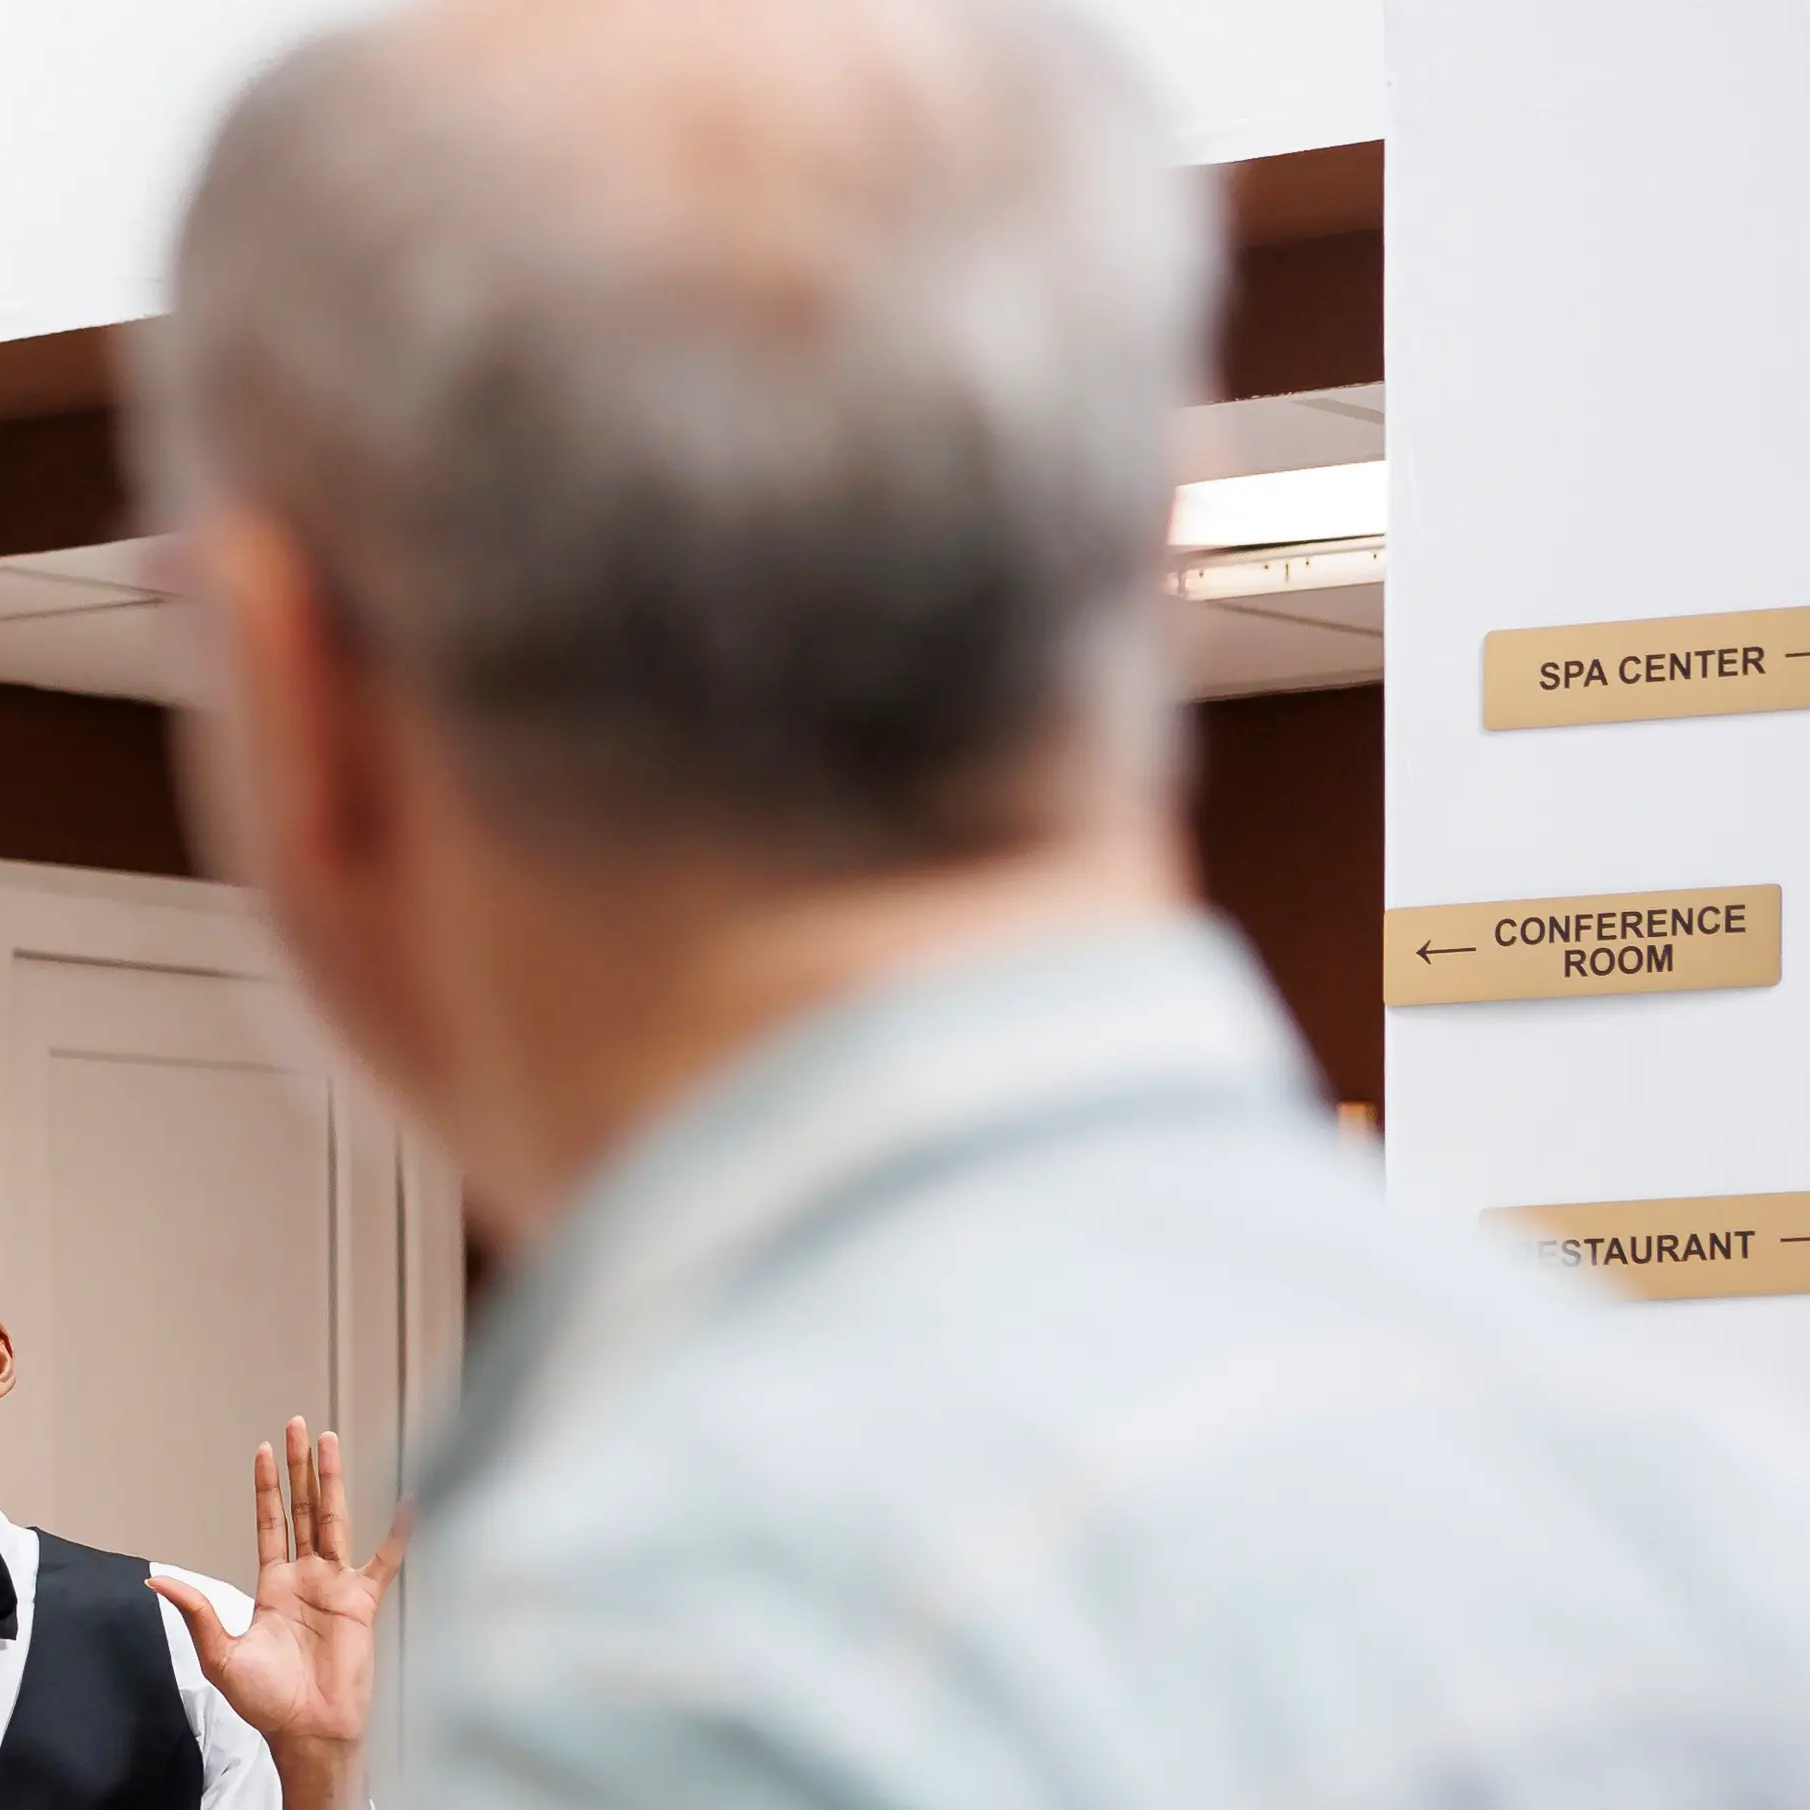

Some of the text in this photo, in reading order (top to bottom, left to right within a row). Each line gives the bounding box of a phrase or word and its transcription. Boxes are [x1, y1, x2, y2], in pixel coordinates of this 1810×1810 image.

[1539, 646, 1766, 691] SPA CENTER
[1494, 904, 1746, 947] CONFERENCE
[1564, 943, 1674, 978] ROOM
[1512, 1230, 1756, 1268] ESTAURANT
